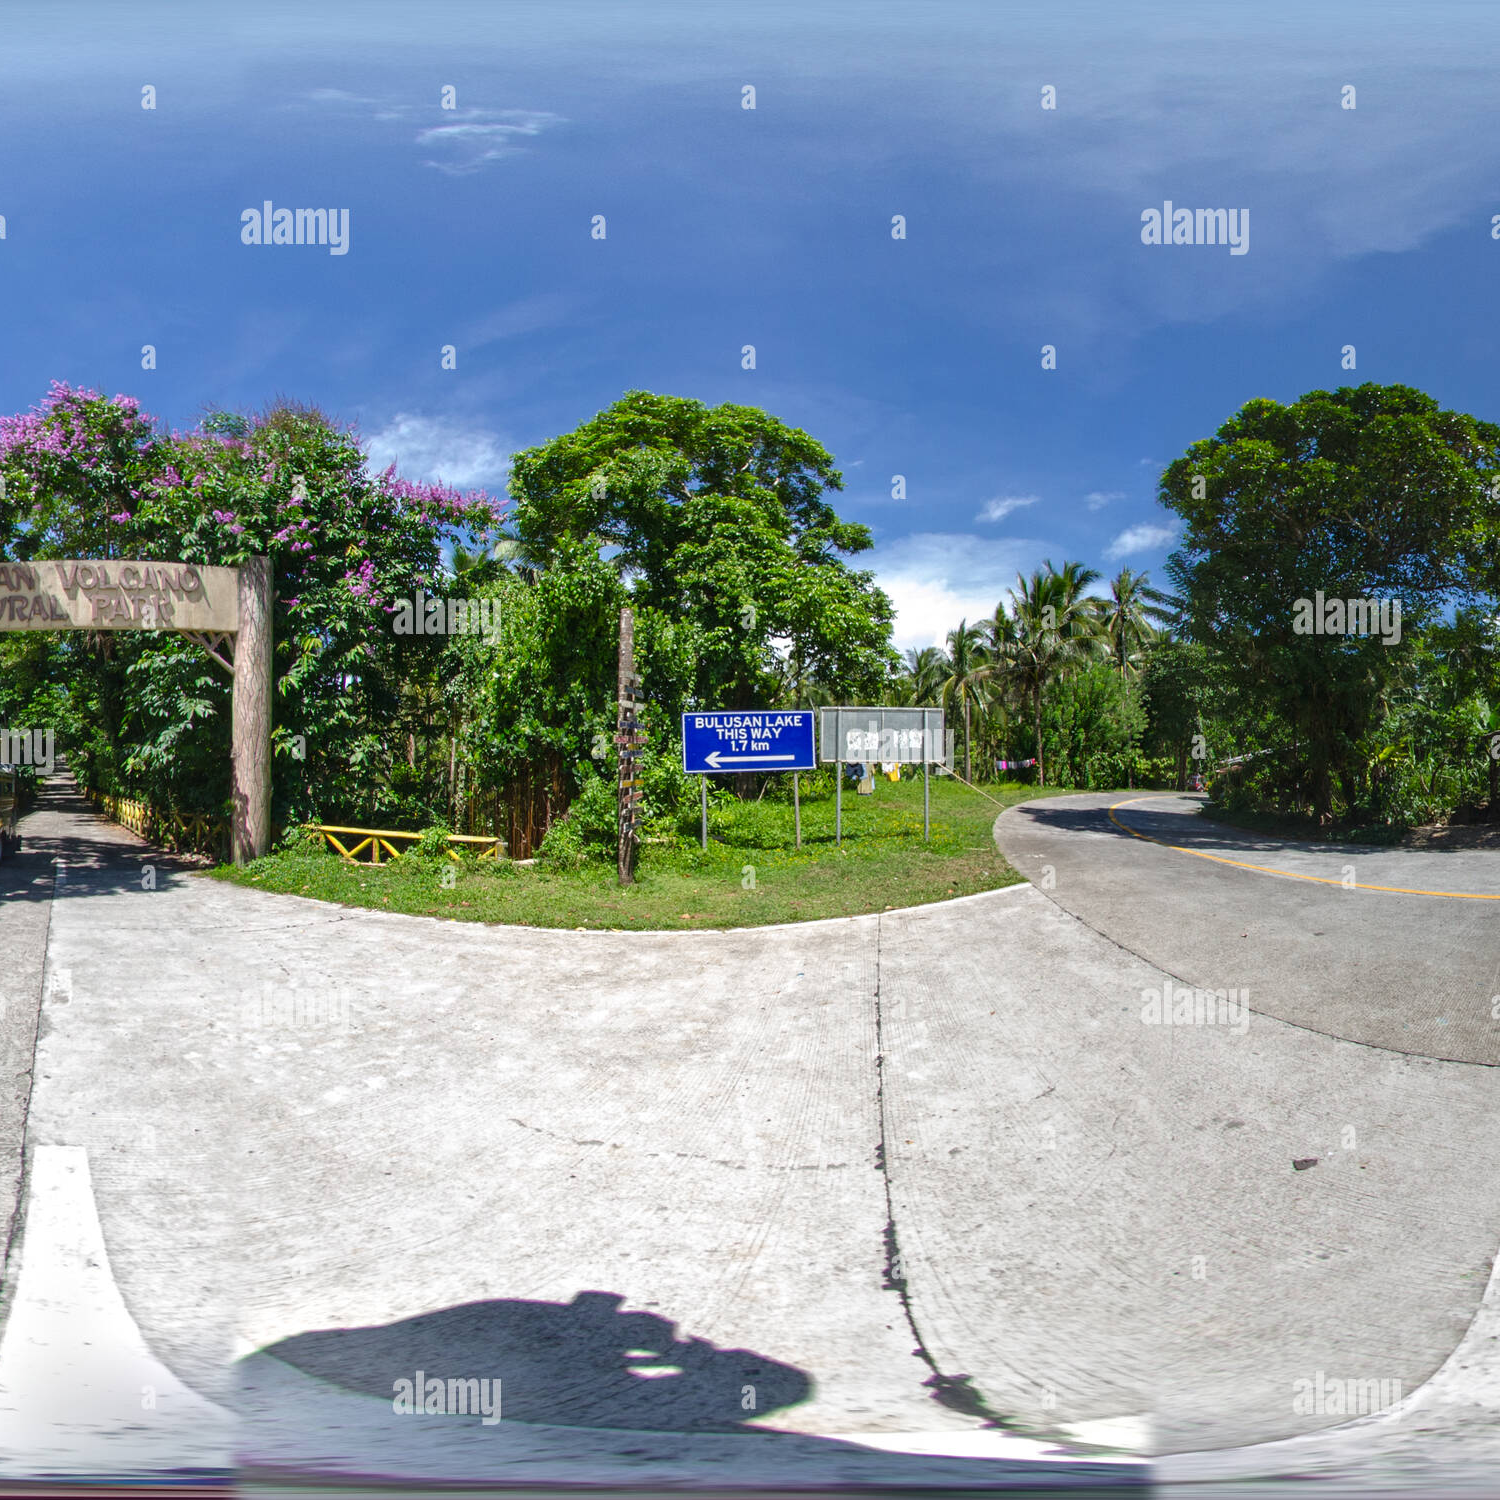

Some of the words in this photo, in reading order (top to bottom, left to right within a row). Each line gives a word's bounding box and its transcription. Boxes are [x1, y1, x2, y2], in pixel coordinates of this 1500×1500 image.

[55, 563, 201, 593] VOLCANO
[92, 595, 173, 622] PARK
[695, 716, 762, 728] BULUSAN
[765, 715, 802, 727] LAKE
[716, 728, 747, 740] THIS
[750, 727, 782, 739] WAY
[730, 740, 748, 752] 1.7
[751, 741, 769, 751] km
